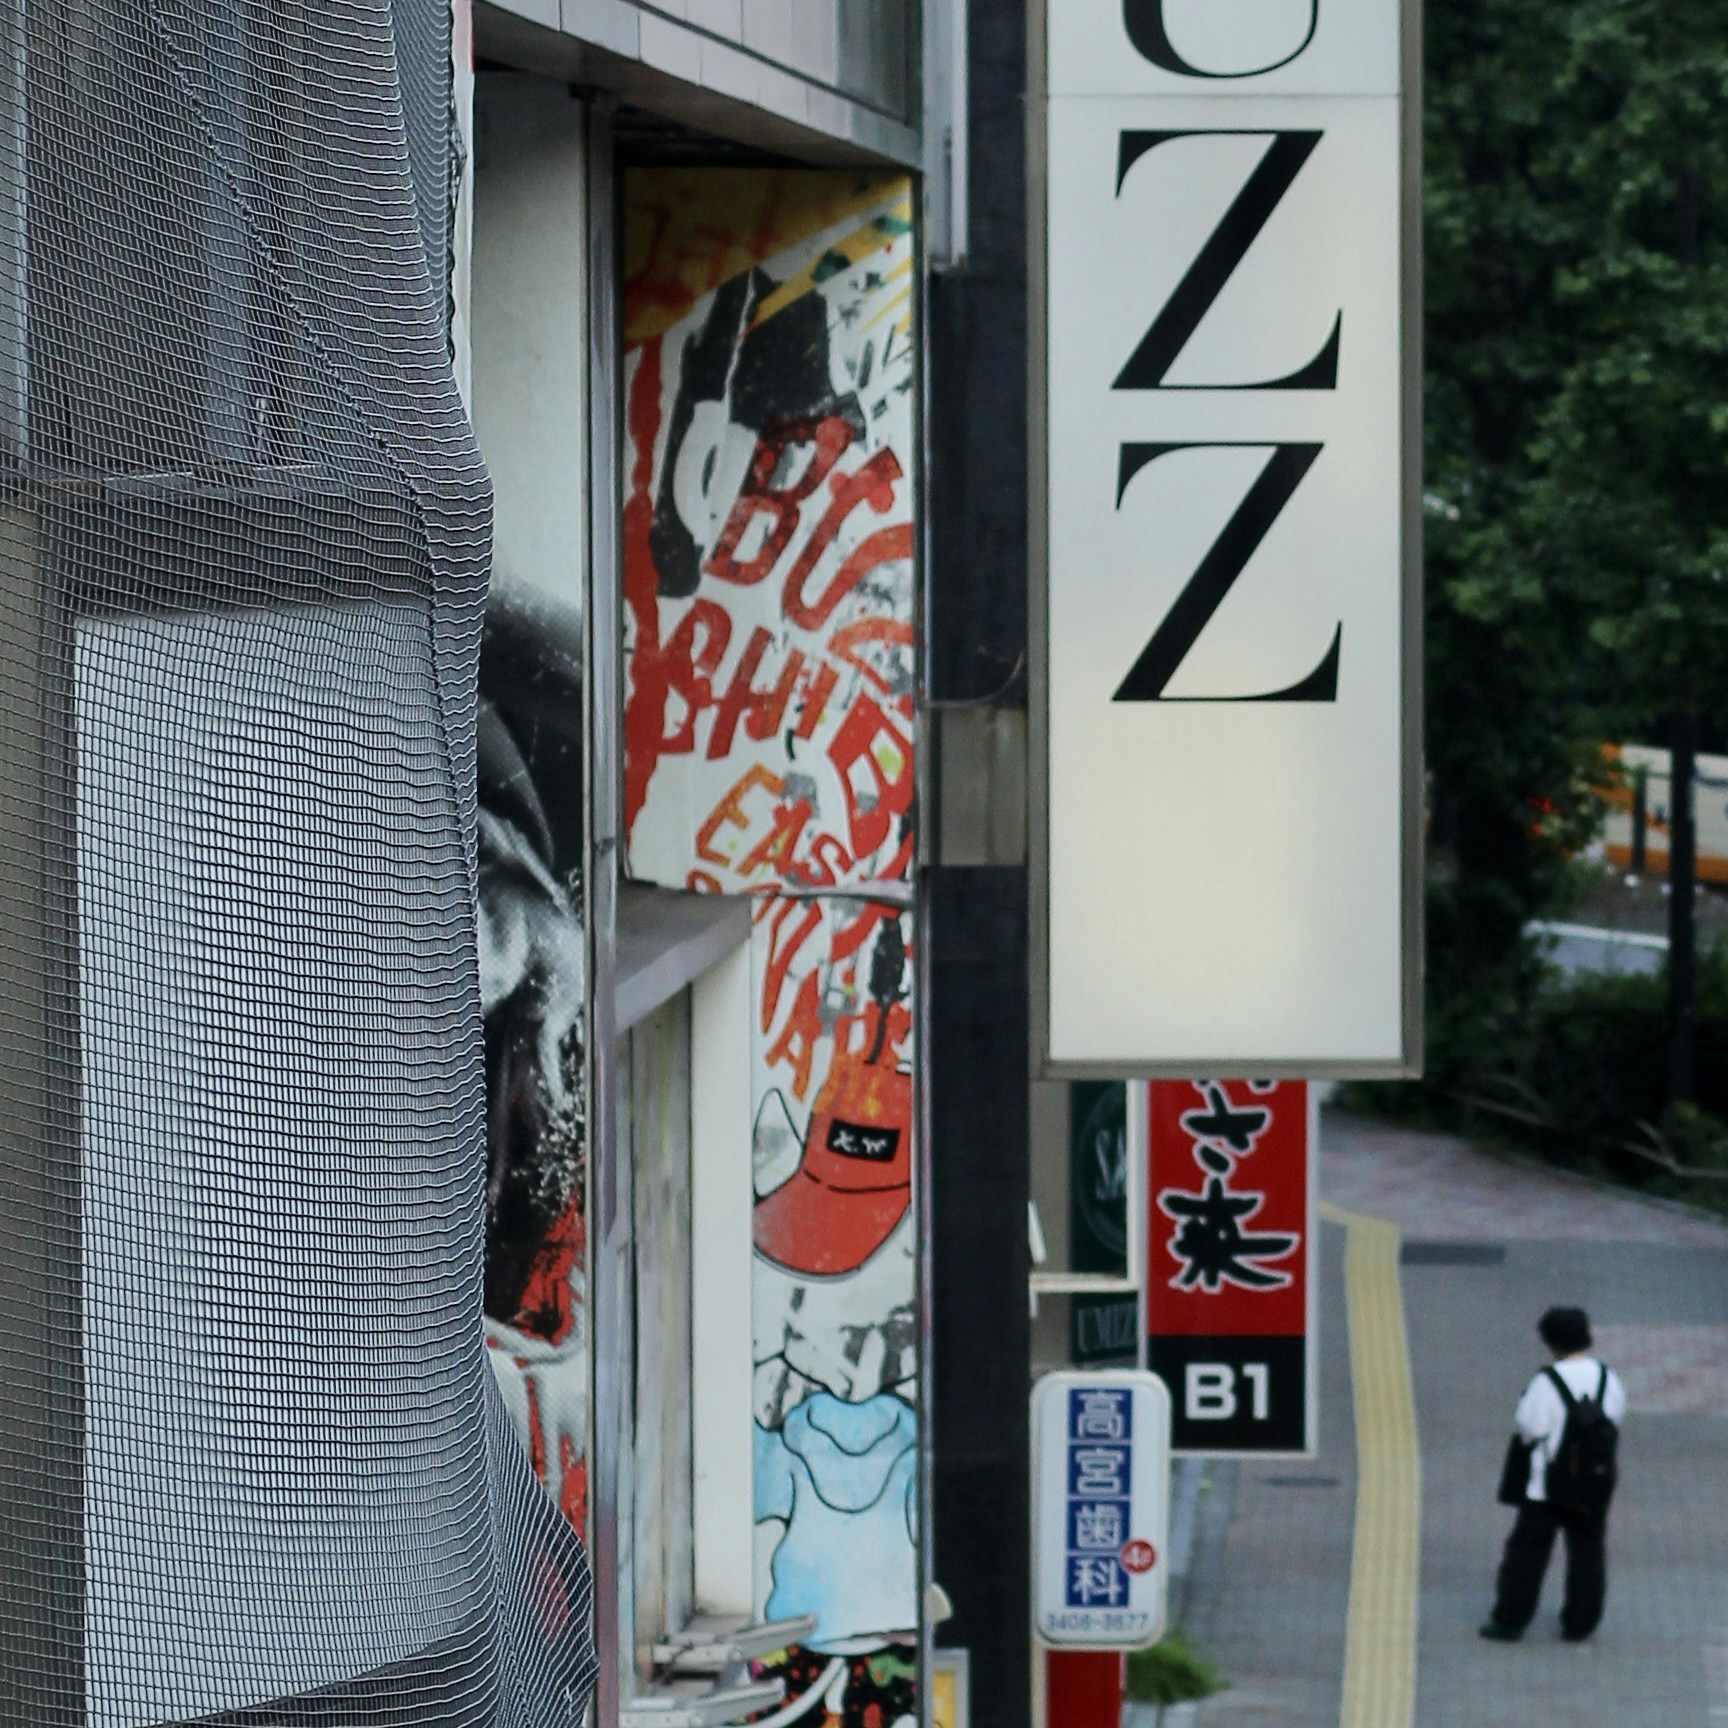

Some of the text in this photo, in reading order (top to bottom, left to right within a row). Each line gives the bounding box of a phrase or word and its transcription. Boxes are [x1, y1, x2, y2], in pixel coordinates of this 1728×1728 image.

[1185, 1363, 1270, 1421] B1
[1074, 1391, 1124, 1606] 高宮歯科
